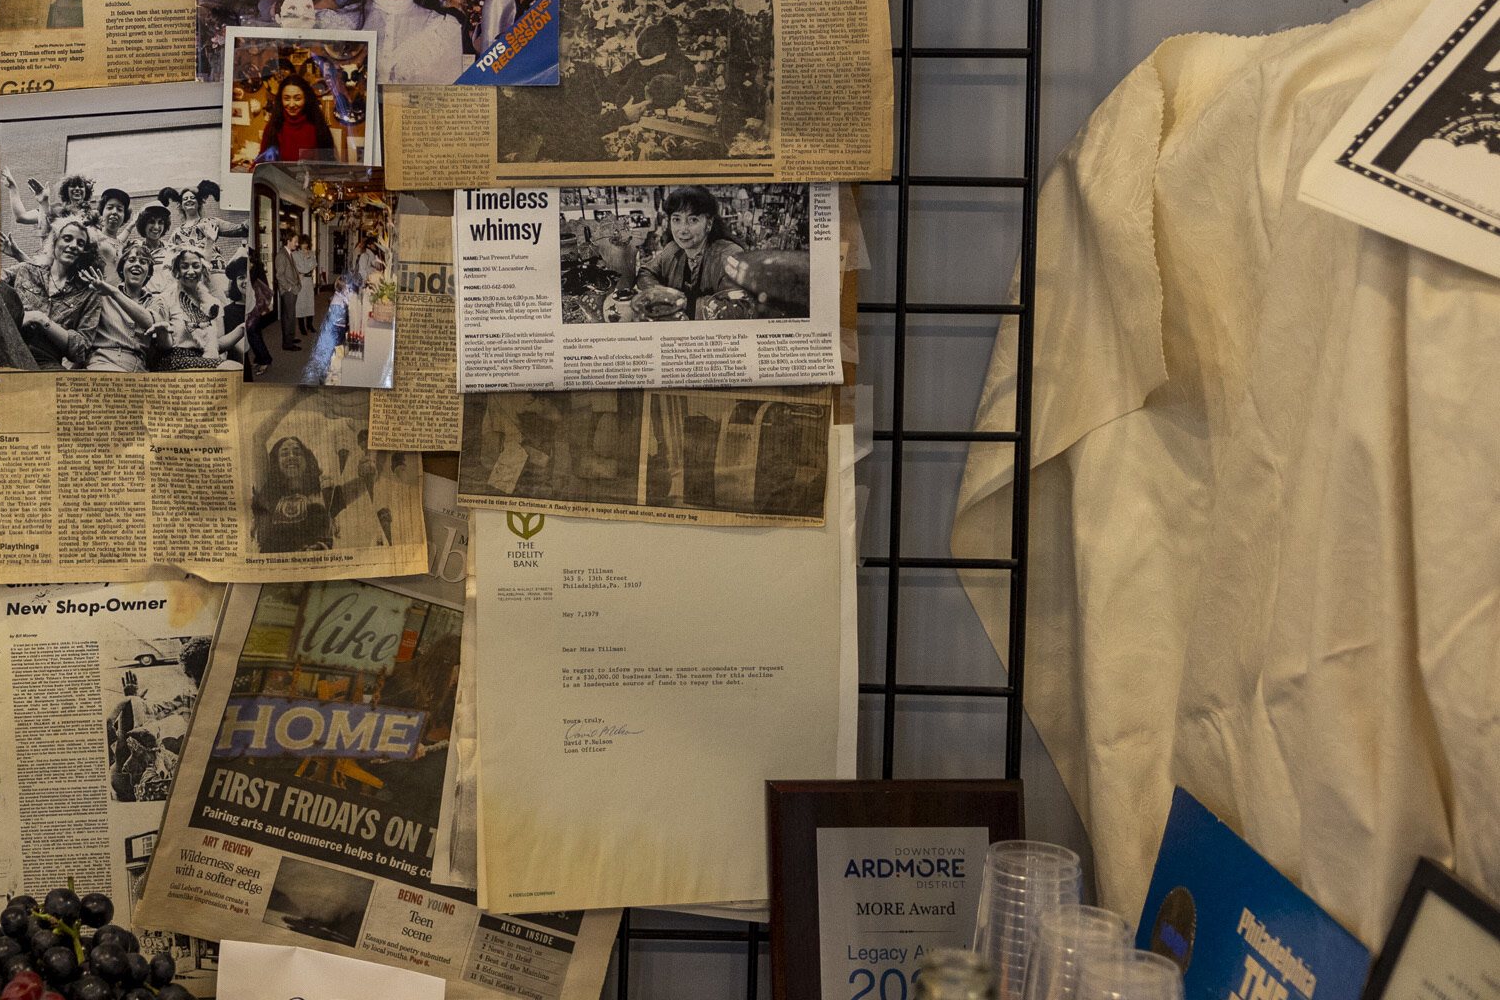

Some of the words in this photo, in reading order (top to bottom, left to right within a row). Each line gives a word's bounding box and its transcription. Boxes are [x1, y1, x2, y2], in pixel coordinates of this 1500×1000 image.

[476, 41, 507, 72] TOYS
[505, 10, 540, 46] SANTA
[492, 10, 553, 75] RECESSION
[463, 188, 548, 210] Timeless
[470, 218, 542, 245] whimsy
[57, 598, 167, 616] Shop-Owner
[302, 592, 398, 663] like
[219, 705, 420, 754] HOME
[209, 769, 280, 812] FIRST
[280, 790, 380, 840] FRIDAYS
[384, 816, 422, 852] ON
[202, 835, 219, 848] ART
[222, 840, 253, 857] REVIEW
[203, 806, 240, 826] Pairing
[241, 819, 263, 830] arts
[265, 825, 286, 837] and
[288, 830, 342, 852] commerce
[344, 844, 373, 860] helps
[376, 852, 387, 865] to
[389, 857, 417, 876] bring
[895, 848, 964, 856] DOWNTOWN
[844, 859, 965, 878] ARDMORE
[917, 880, 966, 889] DISTRICT
[856, 903, 904, 915] MORE
[909, 901, 956, 915] Award
[848, 945, 908, 964] Legacy
